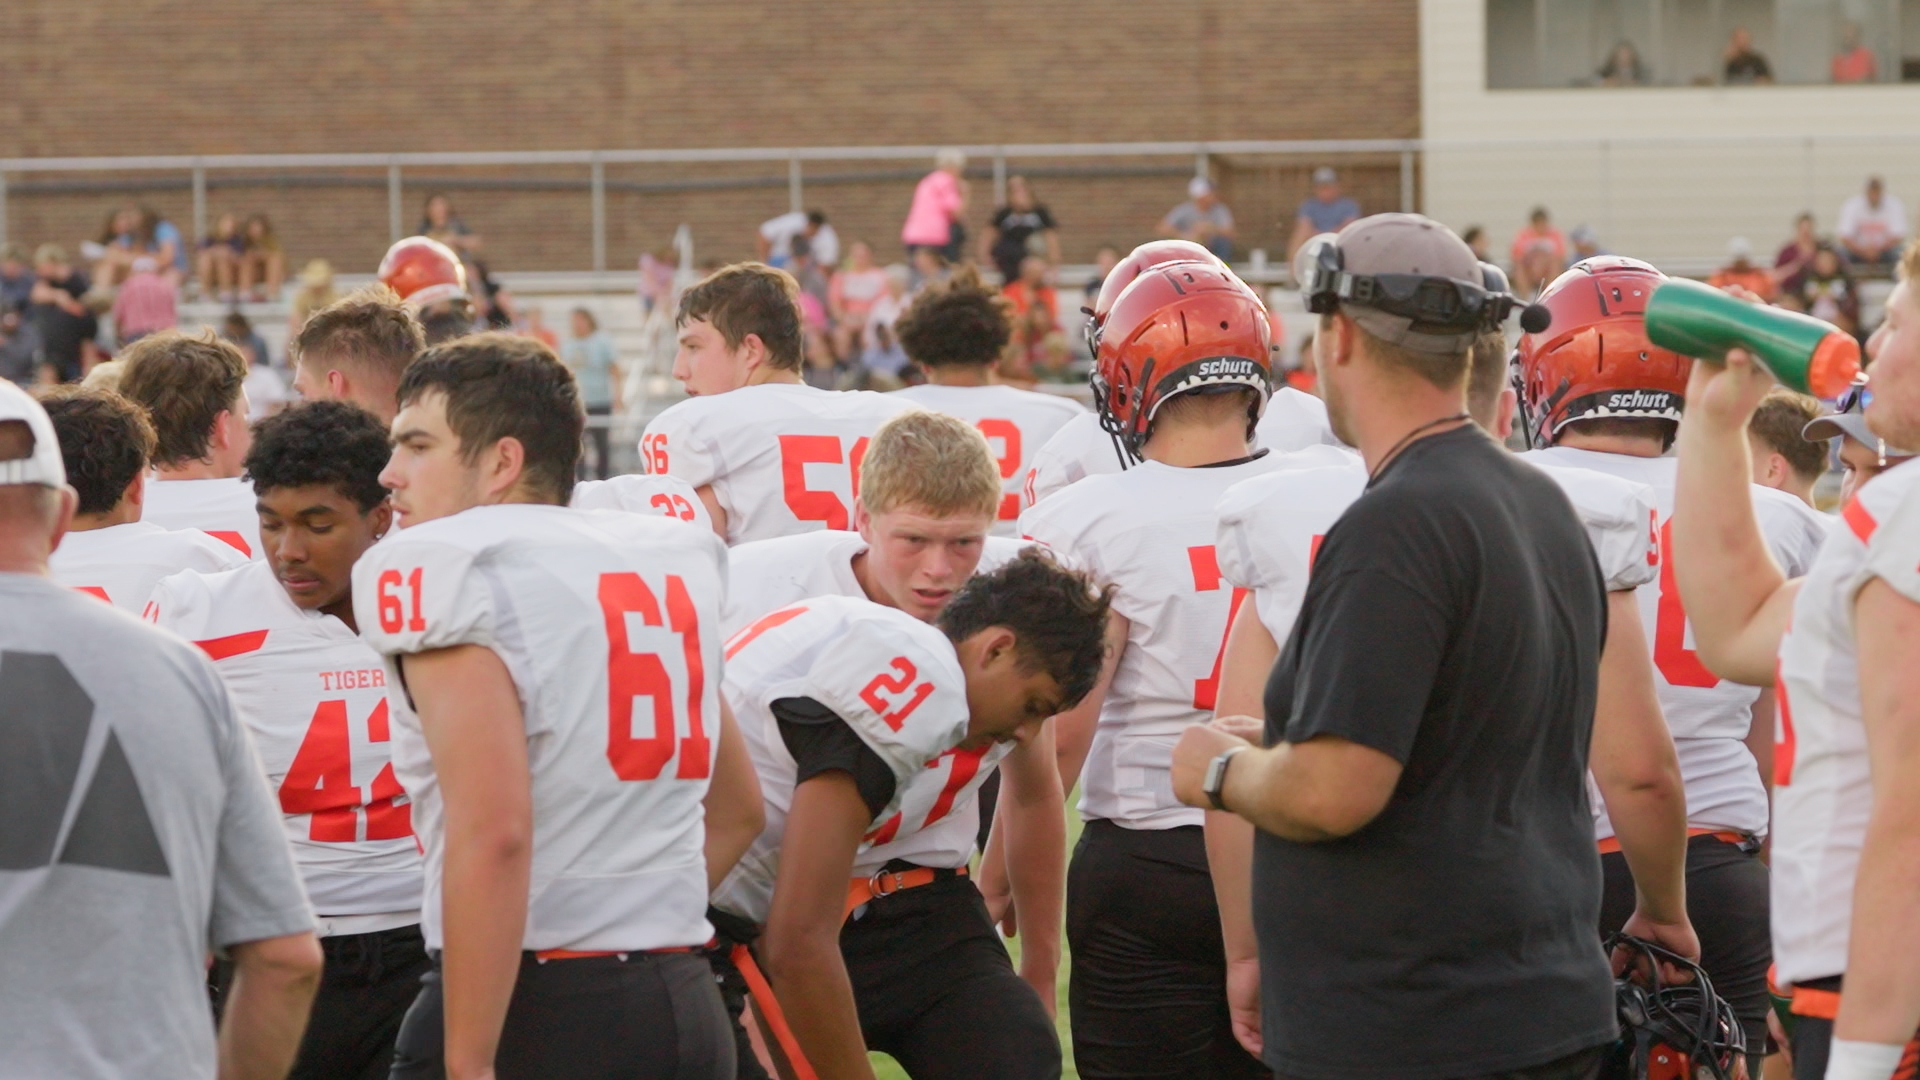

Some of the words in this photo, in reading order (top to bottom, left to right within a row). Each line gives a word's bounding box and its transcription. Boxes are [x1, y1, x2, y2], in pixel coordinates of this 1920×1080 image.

[1199, 358, 1254, 376] schutt
[1608, 390, 1669, 408] schutt
[777, 434, 872, 532] 5
[378, 567, 427, 634] 61
[597, 572, 711, 781] 61
[858, 656, 936, 734] 21
